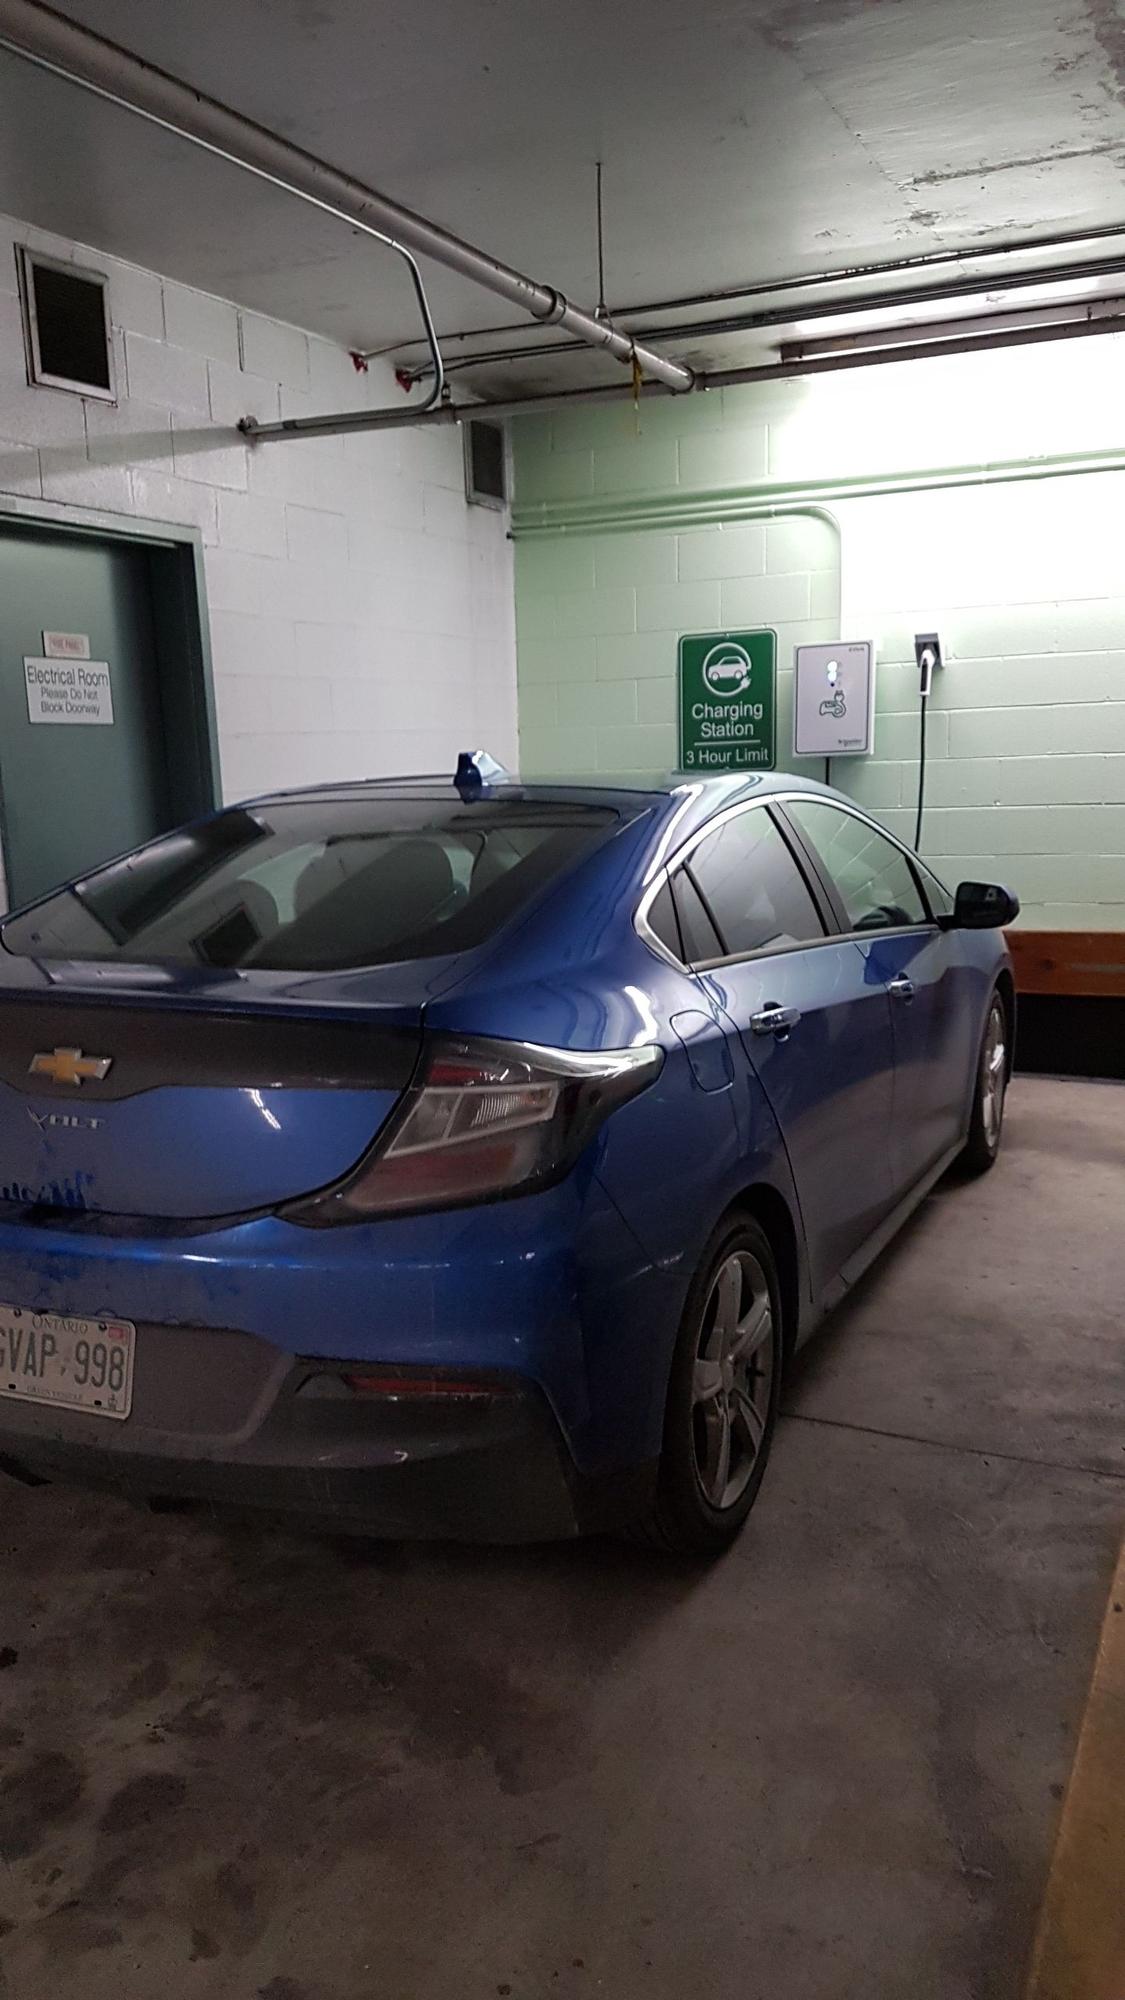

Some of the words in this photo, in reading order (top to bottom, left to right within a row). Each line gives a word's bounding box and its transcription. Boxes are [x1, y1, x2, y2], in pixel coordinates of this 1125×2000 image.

[27, 665, 75, 685] Electrical
[78, 668, 109, 686] Room
[41, 686, 68, 699] Please
[70, 688, 82, 700] Do
[84, 689, 98, 700] Not
[41, 701, 64, 713] Block
[65, 702, 100, 717] Doorway
[692, 701, 763, 721] Charging
[701, 721, 754, 738] Station
[686, 750, 695, 764] 3
[699, 749, 732, 763] Hour
[736, 747, 769, 762] Limit
[26, 1104, 105, 1133] VOLT
[32, 1315, 88, 1335] ONTARIO
[74, 1340, 125, 1392] 998
